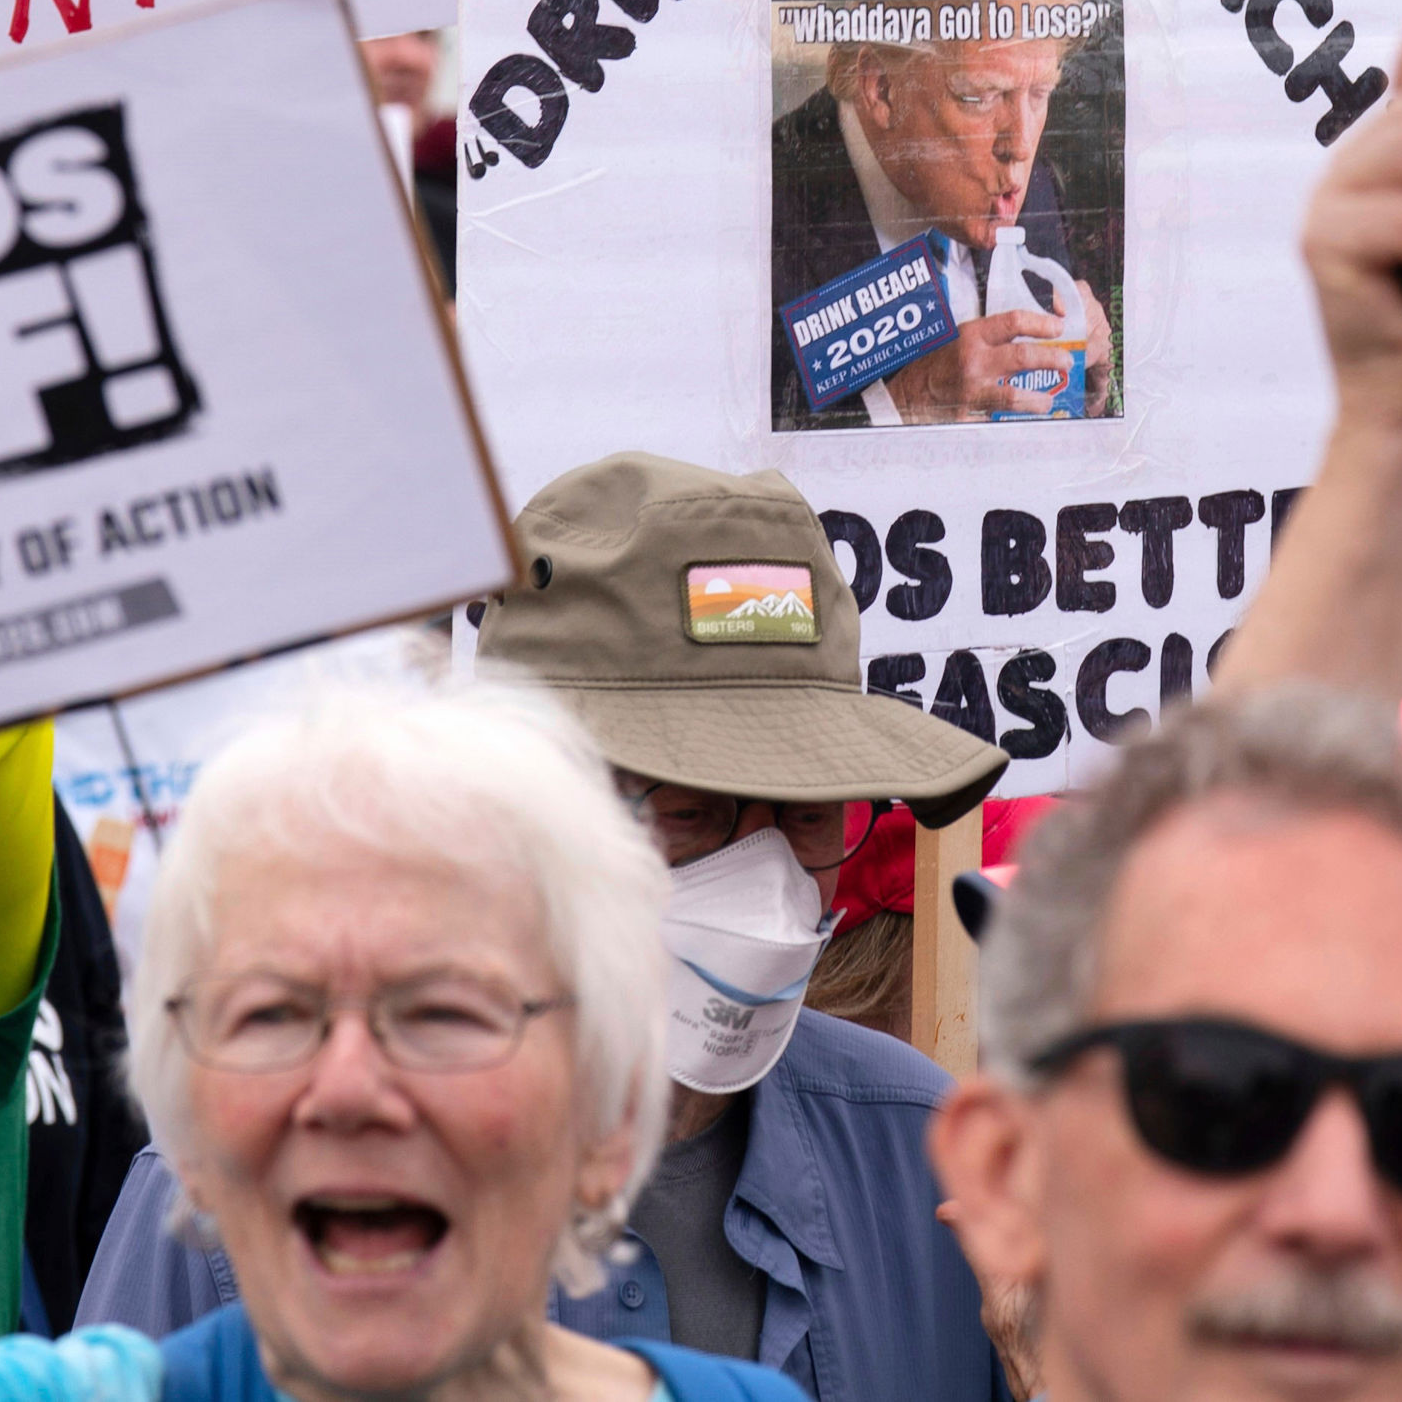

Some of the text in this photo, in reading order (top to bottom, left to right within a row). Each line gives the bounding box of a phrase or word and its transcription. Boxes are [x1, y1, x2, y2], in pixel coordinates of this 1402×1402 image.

[987, 0, 1015, 39] to
[793, 256, 931, 348] DRINK BLEACH
[827, 303, 922, 370] 2020
[816, 320, 945, 394] KEEP AMERICA GREAT!
[17, 520, 78, 577] OF
[97, 471, 283, 558] ACTION
[982, 488, 1317, 617] BETT
[867, 628, 1236, 760] FASCI
